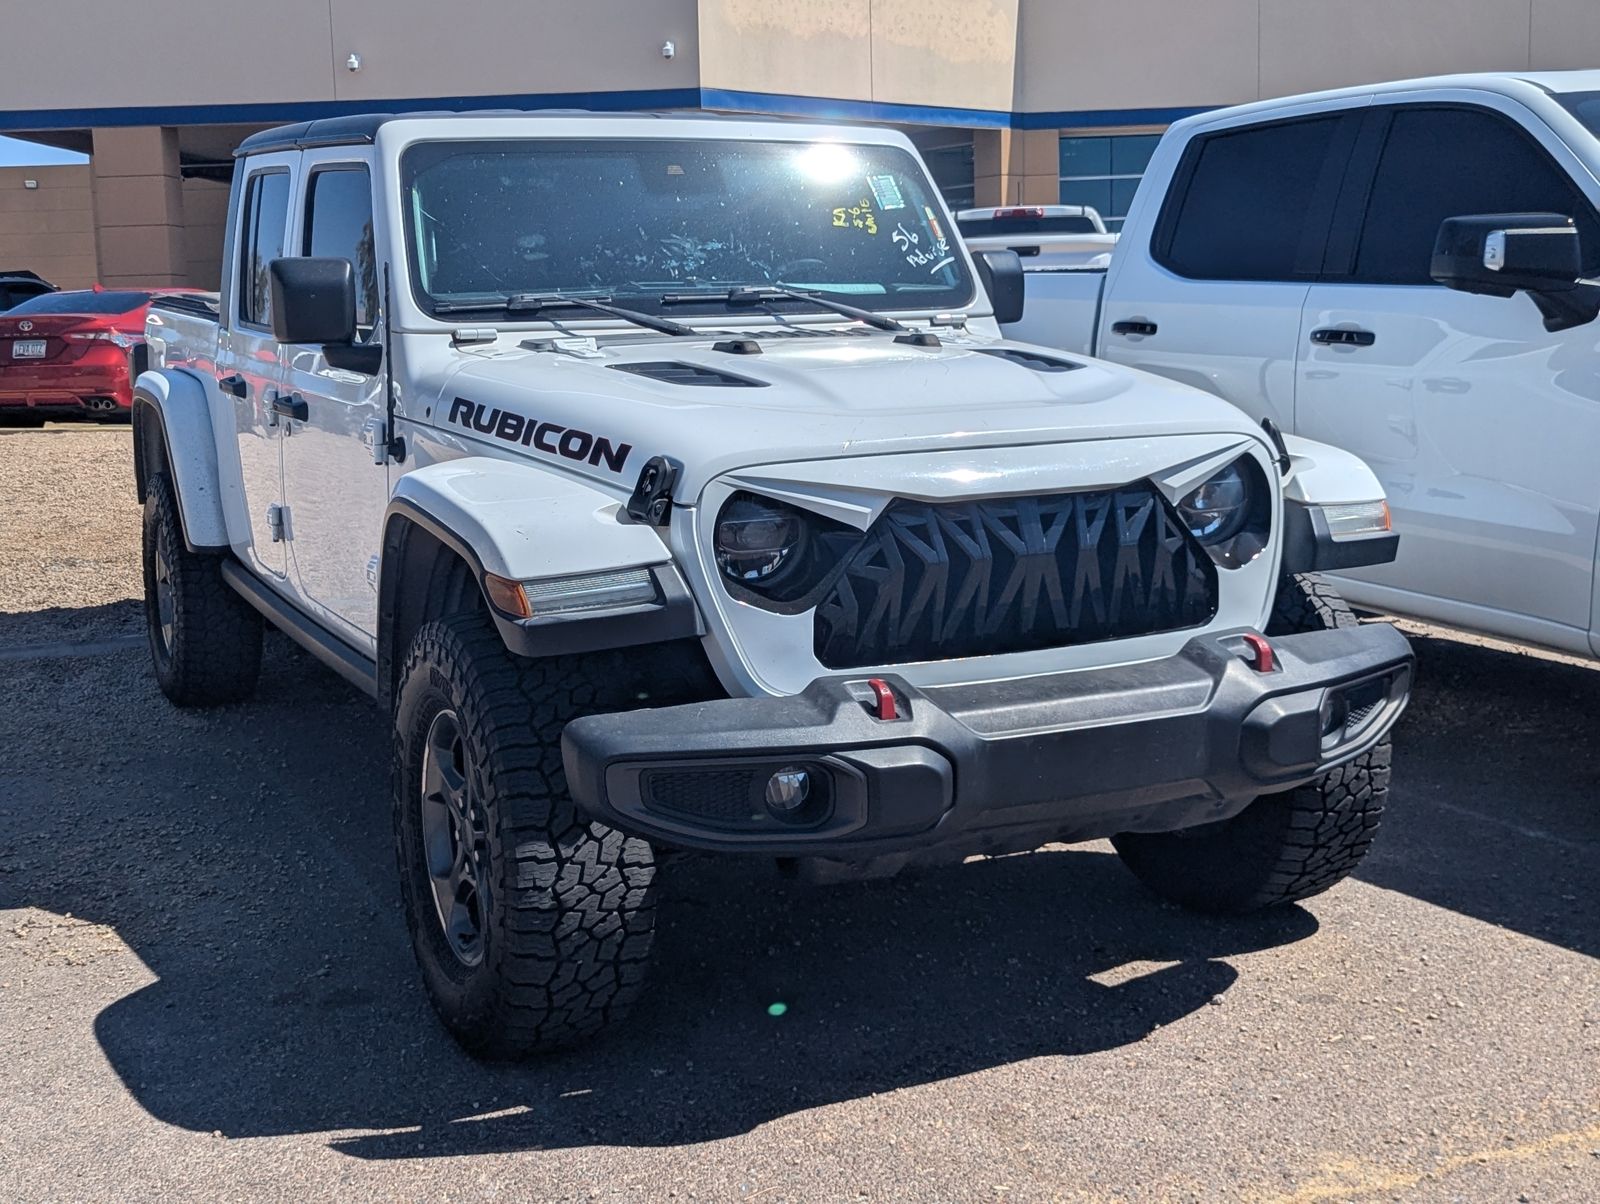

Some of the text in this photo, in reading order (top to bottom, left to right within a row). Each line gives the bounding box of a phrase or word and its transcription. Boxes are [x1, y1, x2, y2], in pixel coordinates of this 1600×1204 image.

[891, 222, 919, 252] 56
[906, 238, 950, 267] Advise
[448, 396, 633, 473] RUBICON
